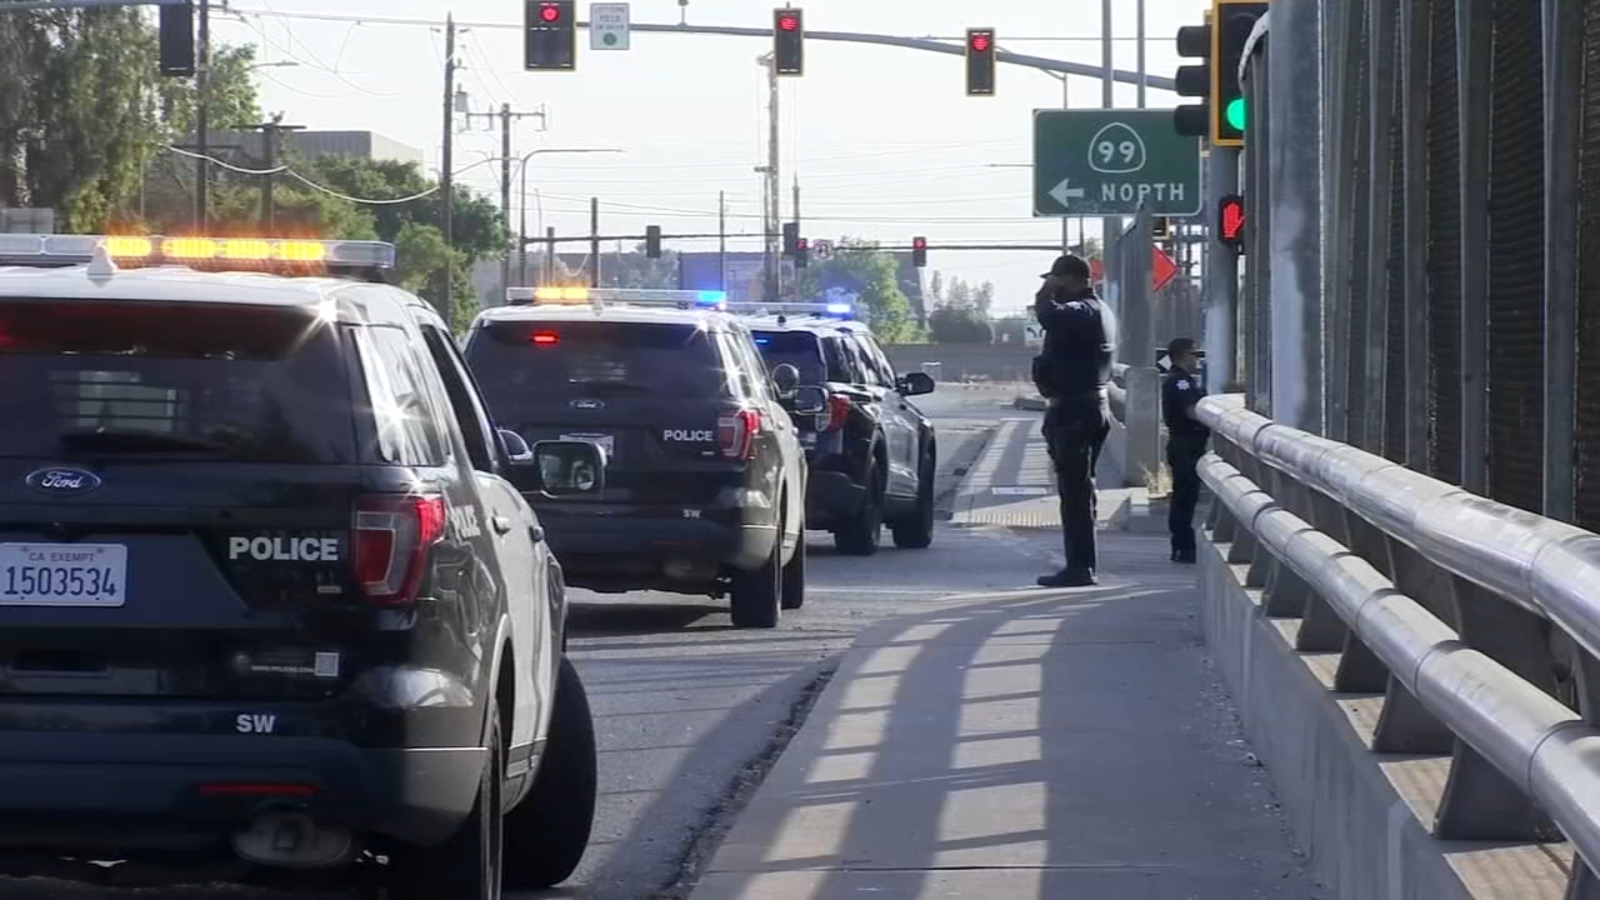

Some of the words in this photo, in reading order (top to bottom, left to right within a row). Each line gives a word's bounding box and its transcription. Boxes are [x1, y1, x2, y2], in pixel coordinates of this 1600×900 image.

[1098, 141, 1135, 163] 99
[663, 430, 713, 441] POLICE
[41, 471, 83, 488] Ford
[683, 509, 701, 518] SW
[28, 552, 45, 562] CA
[51, 552, 95, 562] EXEMPT
[229, 537, 339, 561] POLICE
[4, 566, 116, 597] 1503534
[236, 714, 275, 733] SW
